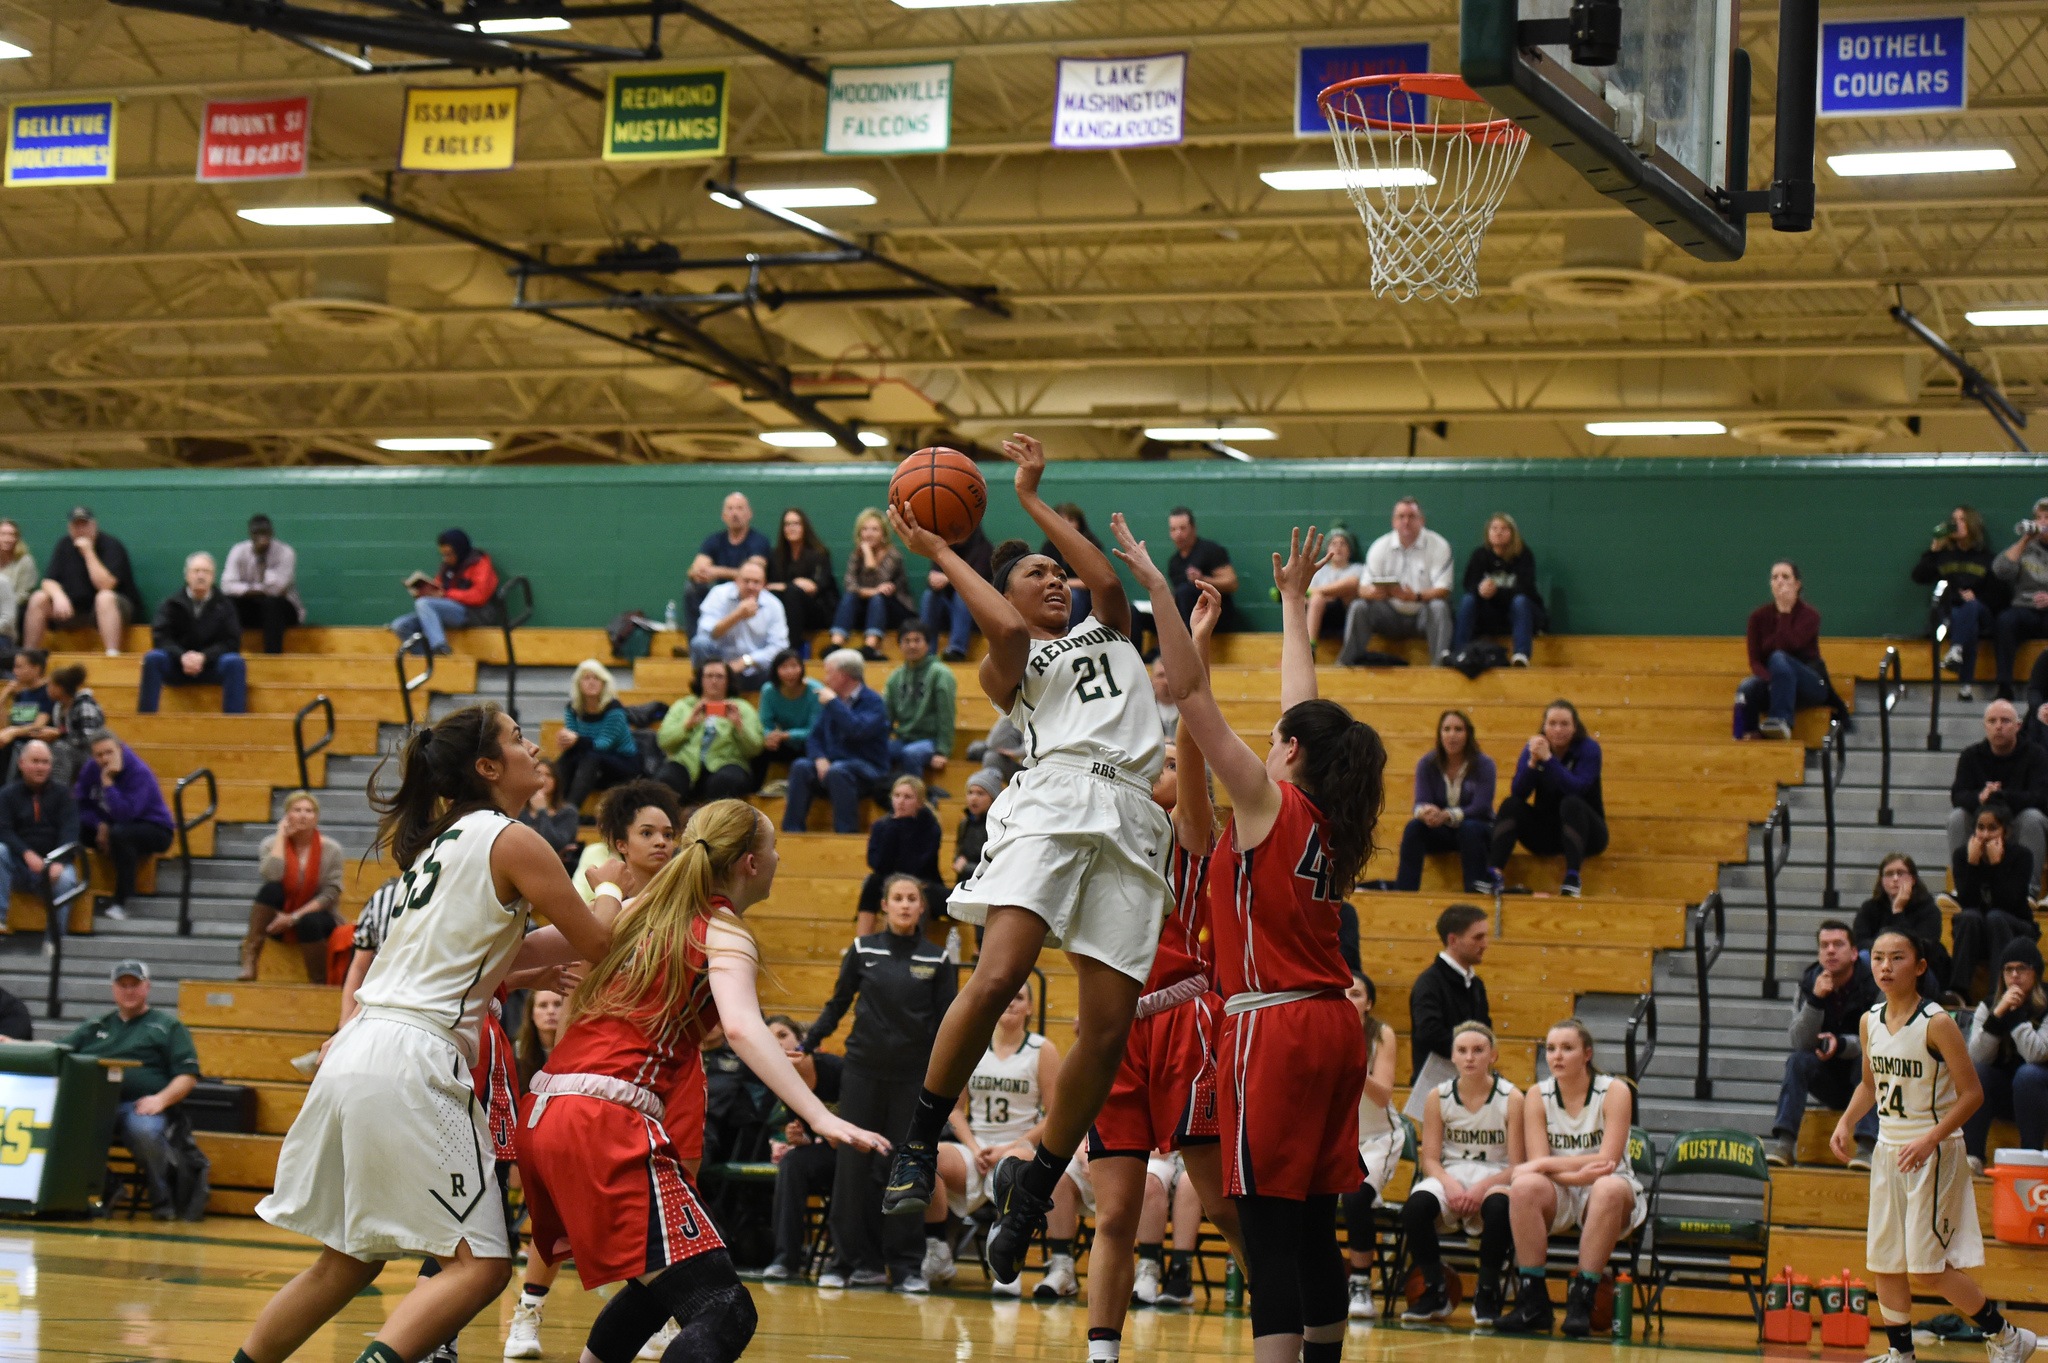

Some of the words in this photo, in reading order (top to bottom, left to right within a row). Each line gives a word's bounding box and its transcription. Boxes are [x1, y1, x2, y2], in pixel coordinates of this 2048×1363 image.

[1838, 33, 1947, 61] BOTHELL
[1095, 64, 1148, 87] LAKE
[1833, 69, 1949, 98] COUGARS
[620, 84, 717, 110] REDMOND
[1063, 87, 1178, 114] WASHINGTON
[17, 114, 107, 138] BELLEVUE
[210, 113, 277, 137] MOUNT
[613, 117, 718, 143] MUSTANGS
[842, 113, 930, 137] FALCONS
[1062, 115, 1175, 140] KANGAROOS
[207, 142, 302, 167] WILDCATS
[423, 134, 494, 156] EAGLES
[1072, 652, 1122, 703] 21
[1091, 761, 1117, 780] RHS
[1872, 1055, 1923, 1078] EDMOND
[985, 1095, 1009, 1123] 13
[1204, 1090, 1216, 1120] J
[1878, 1081, 1907, 1119] 24
[495, 1118, 508, 1148] J
[1446, 1128, 1505, 1145] REDMOND
[1677, 1138, 1755, 1167] MUSTANGS
[451, 1172, 467, 1198] R
[678, 1204, 702, 1240] J
[1792, 1290, 1805, 1306] G
[1827, 1292, 1841, 1308] G
[1852, 1296, 1865, 1311] G
